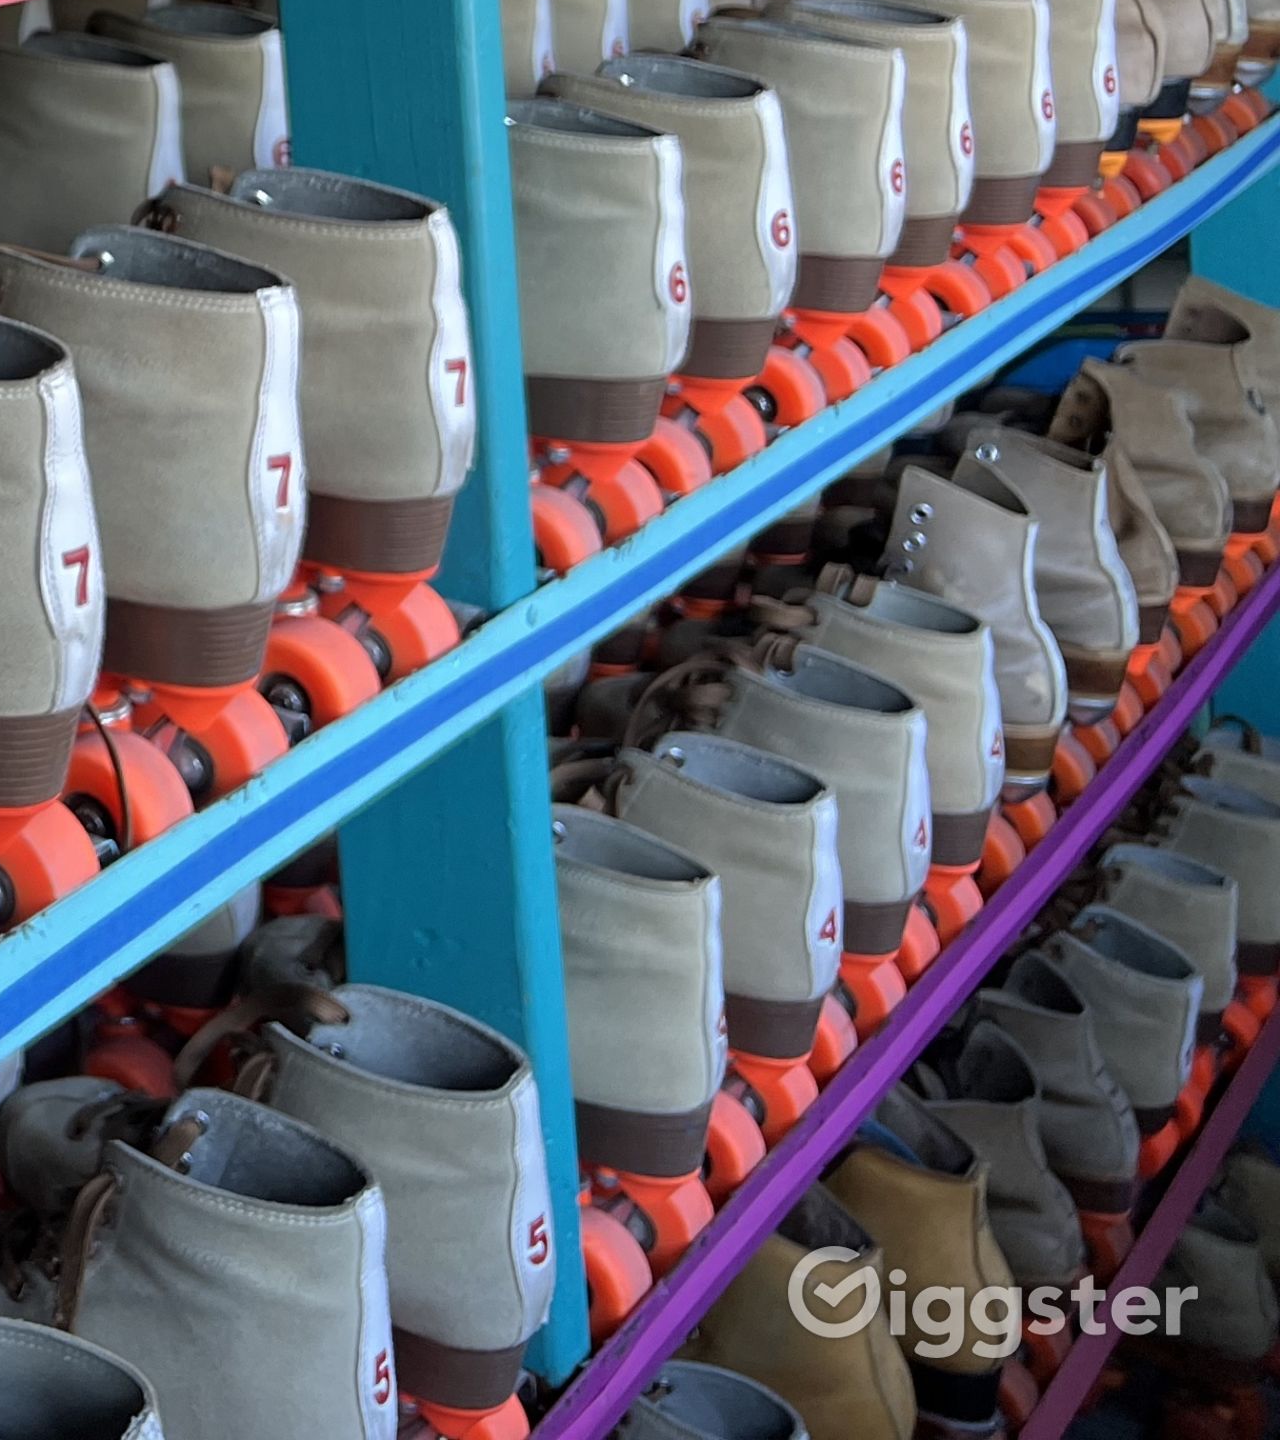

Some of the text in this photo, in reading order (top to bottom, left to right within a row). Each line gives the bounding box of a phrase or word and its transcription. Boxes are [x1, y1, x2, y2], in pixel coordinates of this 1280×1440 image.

[1103, 65, 1115, 95] 6
[1041, 90, 1053, 120] 6
[960, 122, 973, 157] 6
[891, 159, 903, 194] 6
[771, 210, 791, 249] 6
[669, 262, 686, 303] 6
[448, 360, 467, 405] 7
[269, 455, 292, 508] 7
[63, 547, 90, 606] 7
[912, 816, 927, 848] 4
[818, 906, 837, 944] 4
[529, 1212, 548, 1265] 5
[375, 1348, 390, 1405] 5
